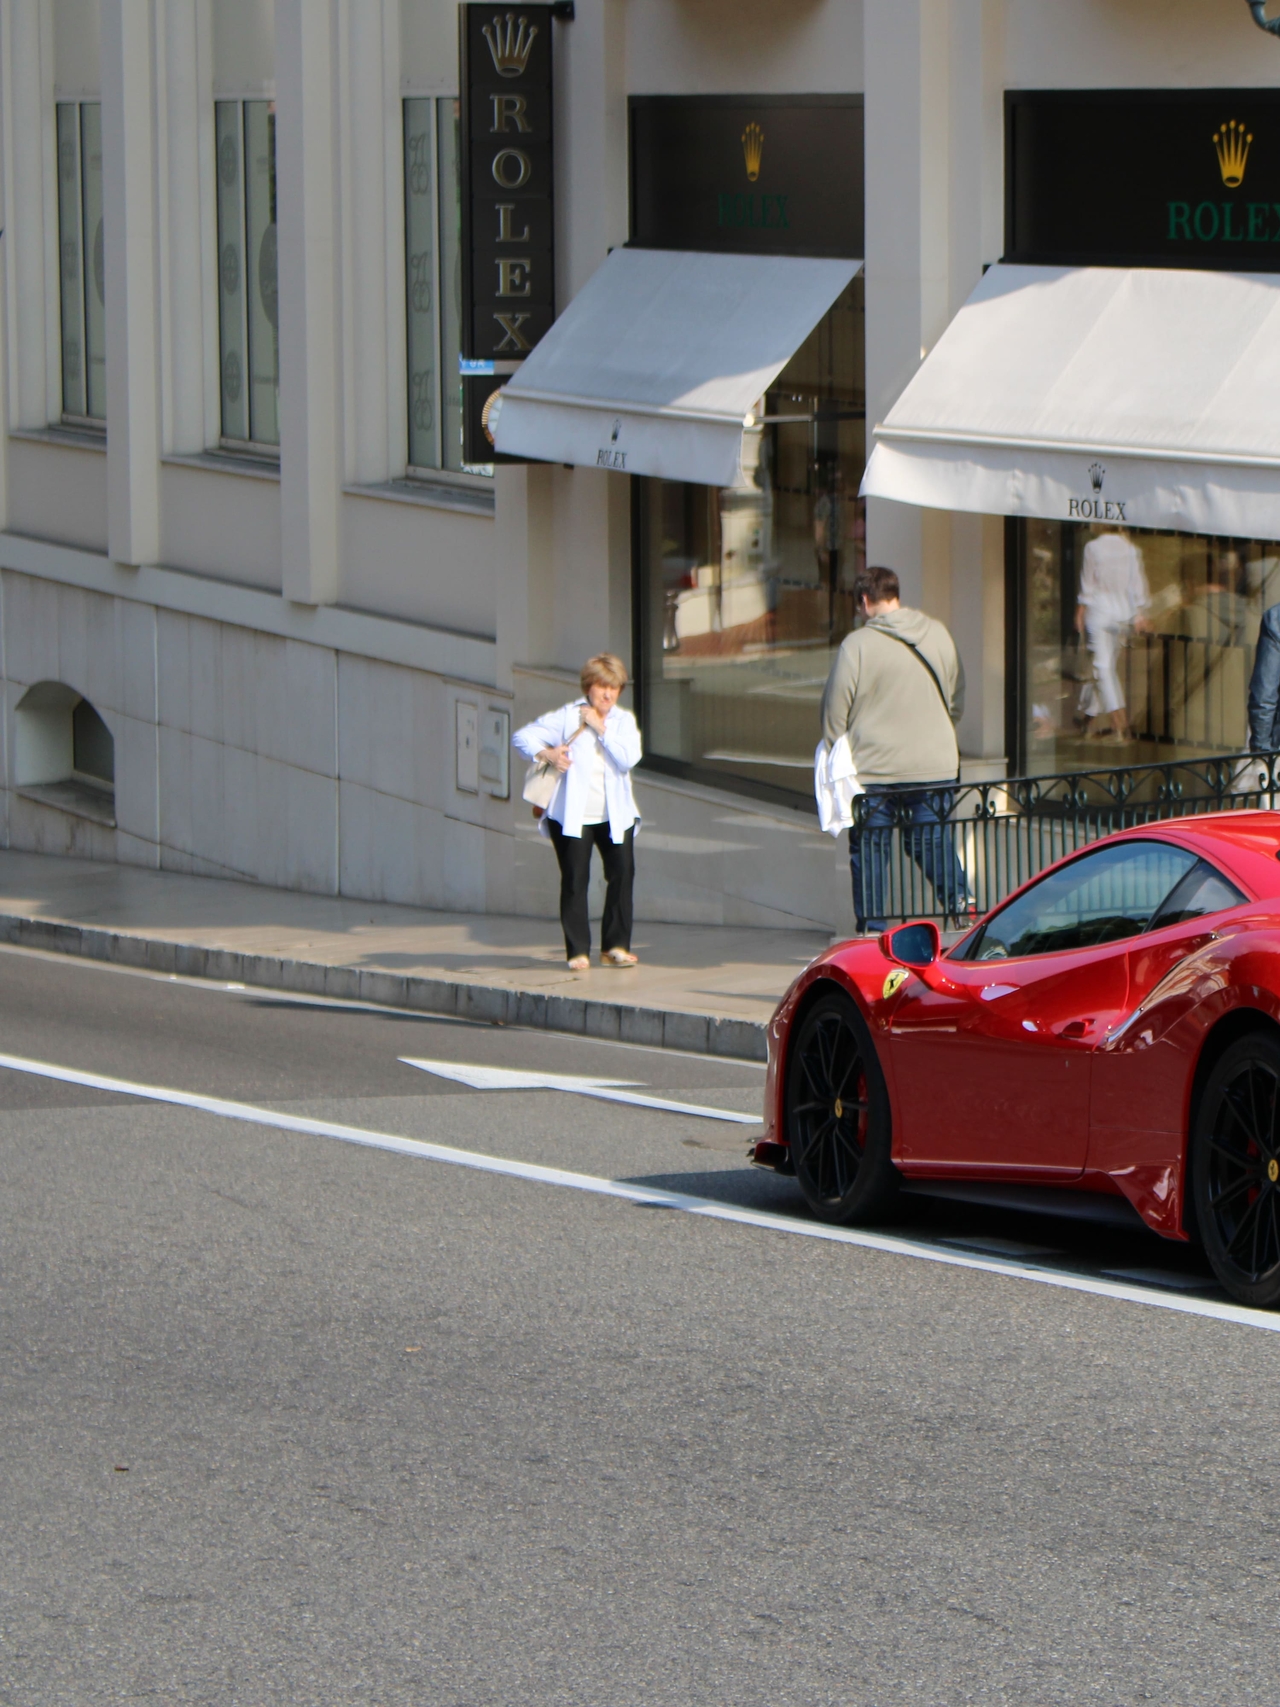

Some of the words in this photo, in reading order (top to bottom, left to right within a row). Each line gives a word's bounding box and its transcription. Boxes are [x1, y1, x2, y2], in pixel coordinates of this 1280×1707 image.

[489, 94, 532, 352] ROLEX
[717, 193, 790, 230] ROLEX
[596, 449, 628, 469] ROLEX
[1067, 498, 1127, 521] ROLEX
